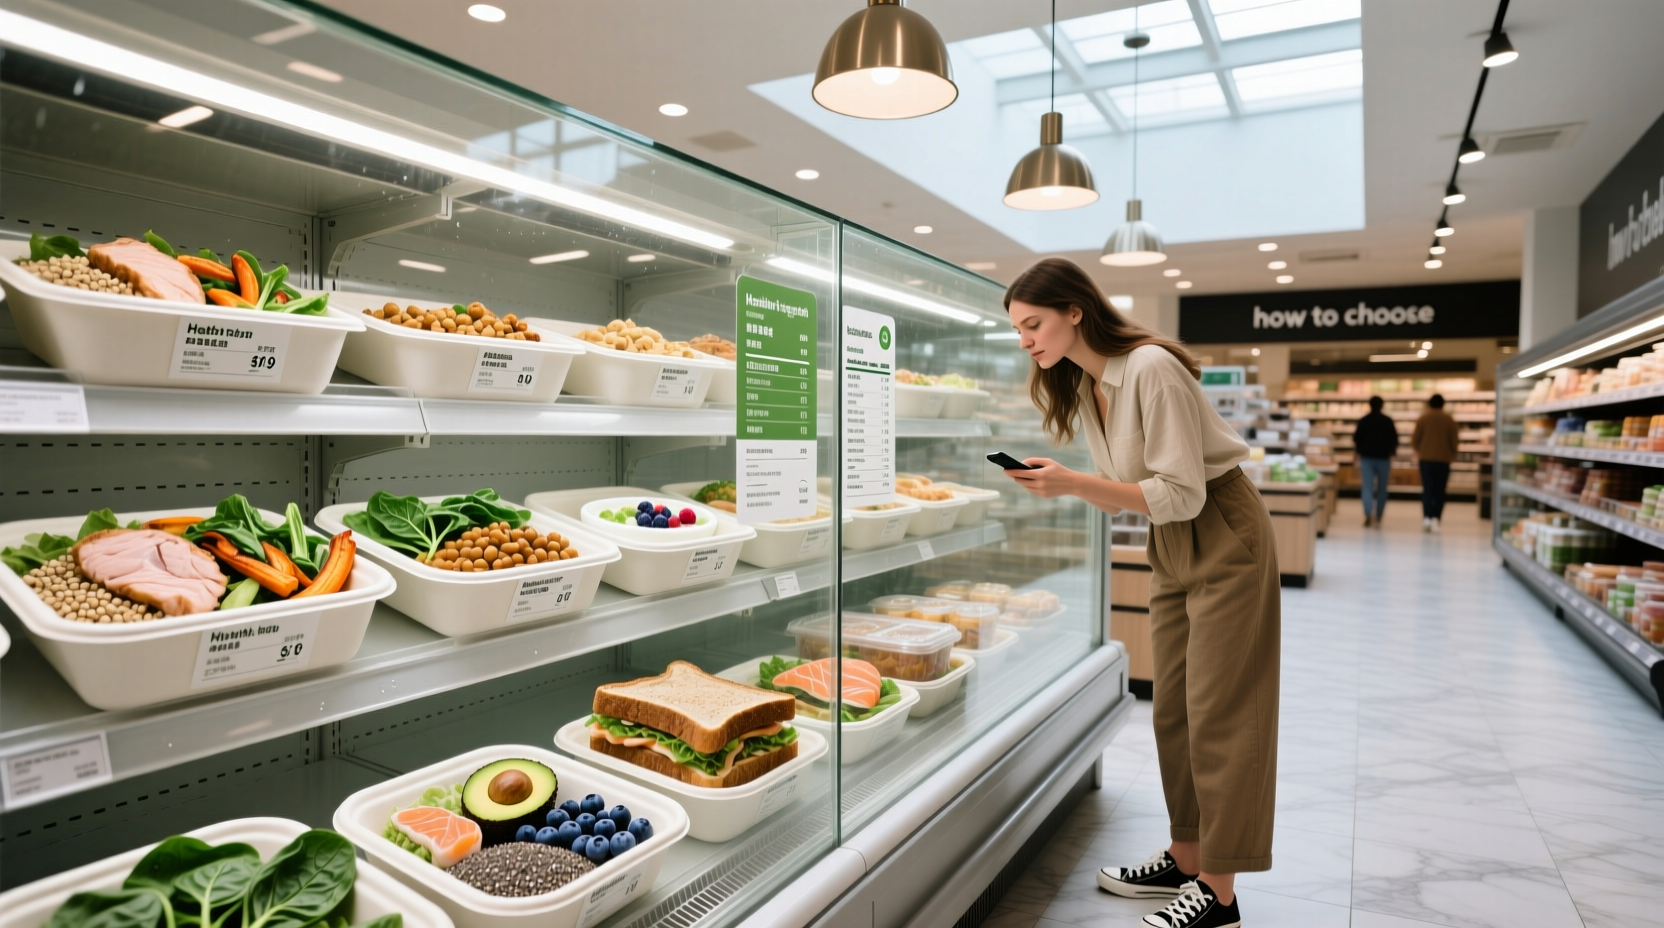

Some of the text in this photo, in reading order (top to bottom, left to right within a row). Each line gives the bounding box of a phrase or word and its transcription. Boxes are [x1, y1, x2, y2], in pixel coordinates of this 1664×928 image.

[1253, 302, 1435, 329] how to choose
